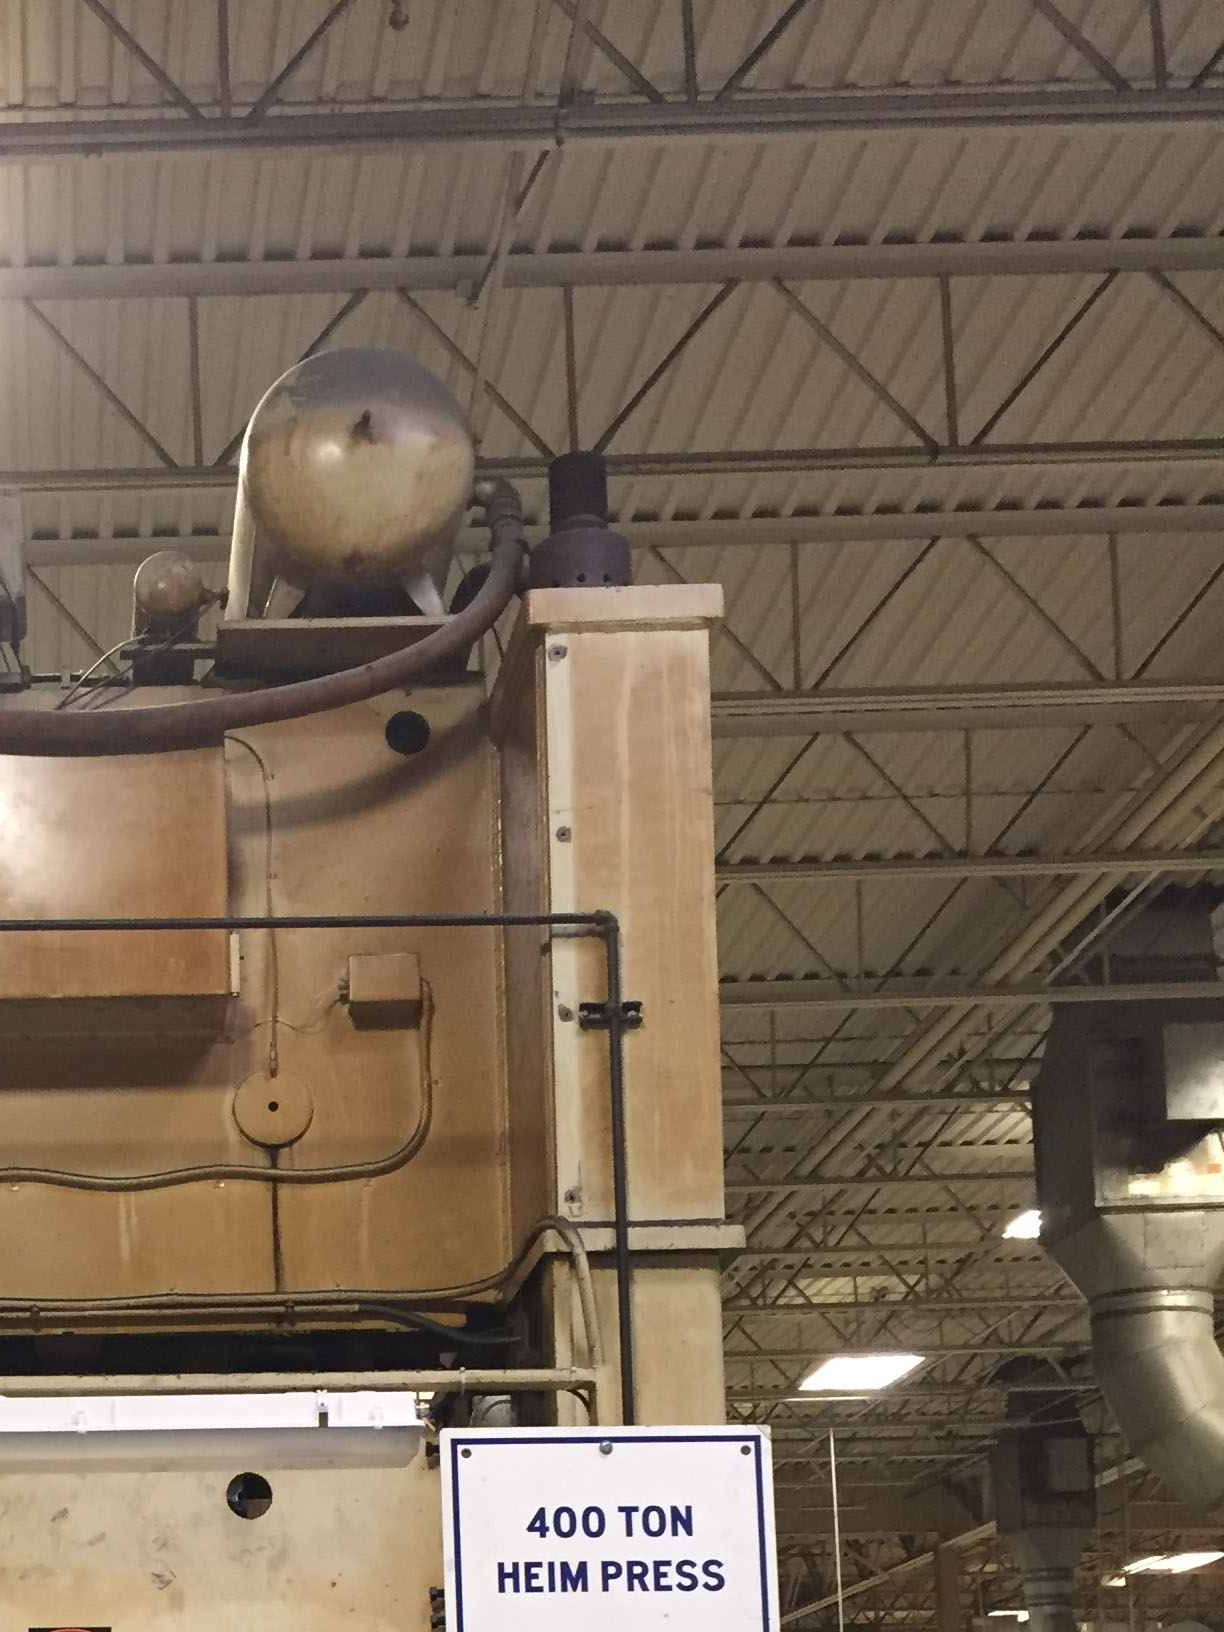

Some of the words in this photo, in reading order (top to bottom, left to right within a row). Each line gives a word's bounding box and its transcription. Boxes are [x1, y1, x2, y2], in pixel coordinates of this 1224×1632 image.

[526, 1506, 606, 1538] 400
[618, 1505, 694, 1537] TON
[497, 1561, 589, 1594] HEIM
[601, 1559, 726, 1593] PRESS
